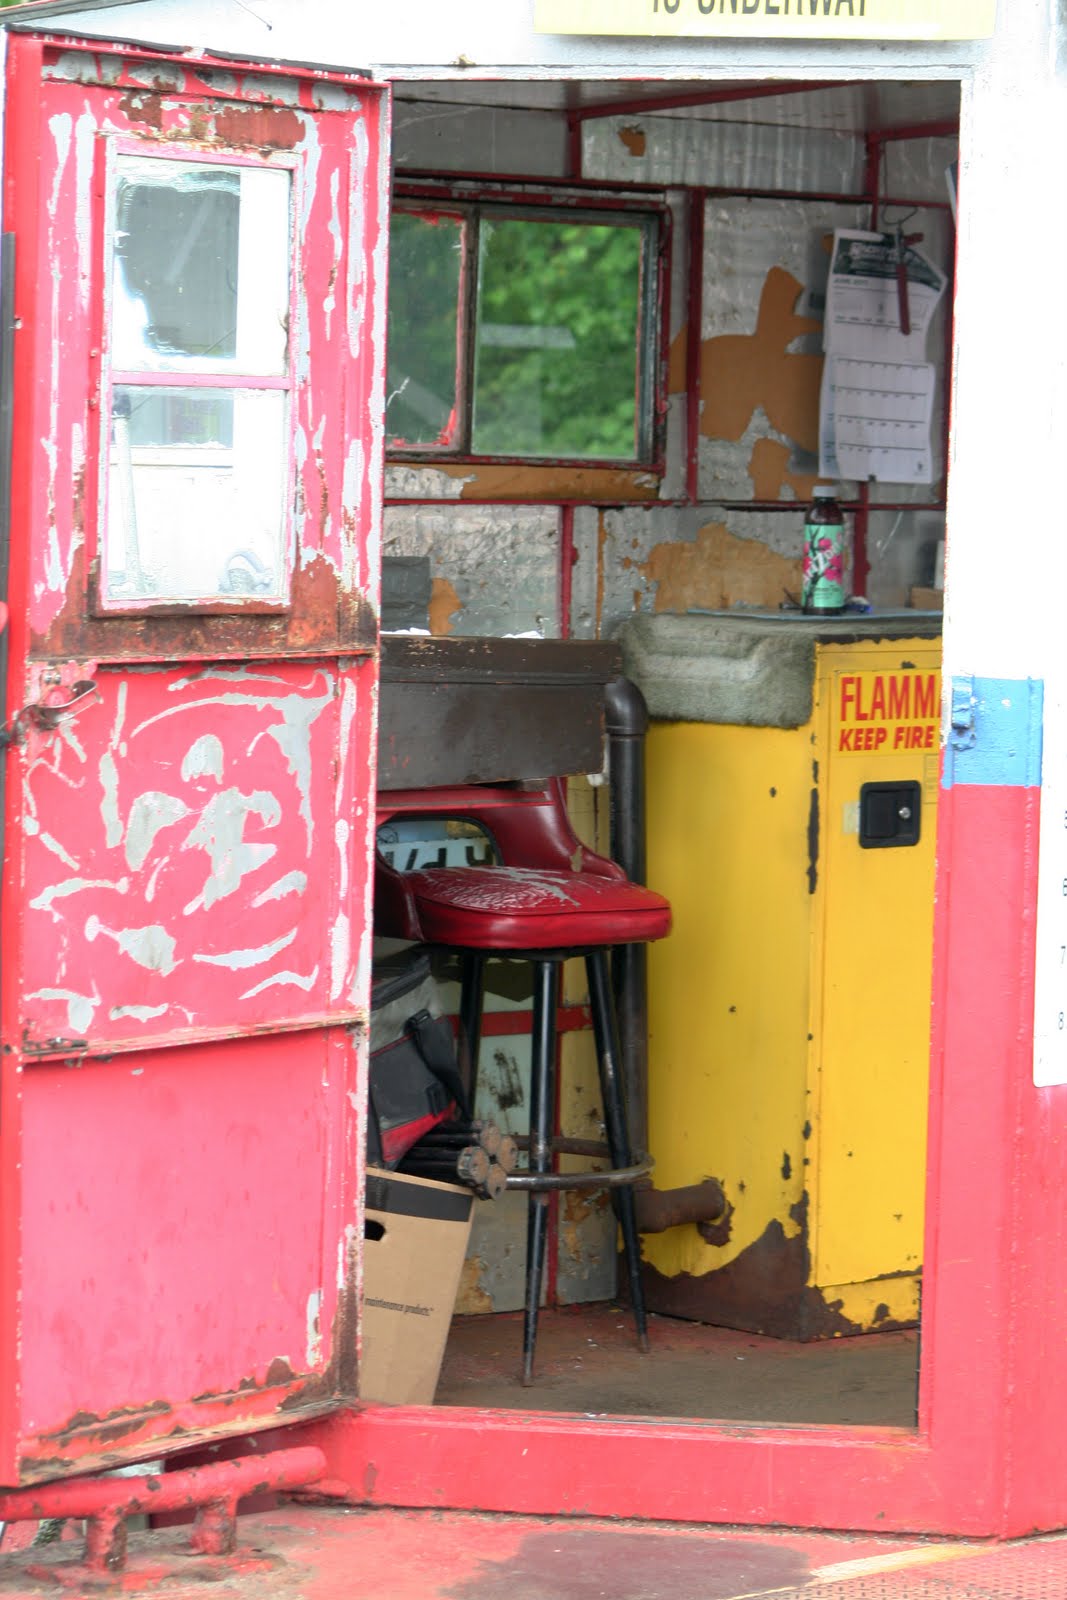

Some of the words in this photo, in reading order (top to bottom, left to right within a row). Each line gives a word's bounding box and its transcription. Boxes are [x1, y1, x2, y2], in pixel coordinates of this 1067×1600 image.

[840, 674, 941, 722] FLAMM
[839, 727, 887, 752] KEEP
[893, 725, 934, 750] FIRE
[1058, 1010, 1065, 1031] 8
